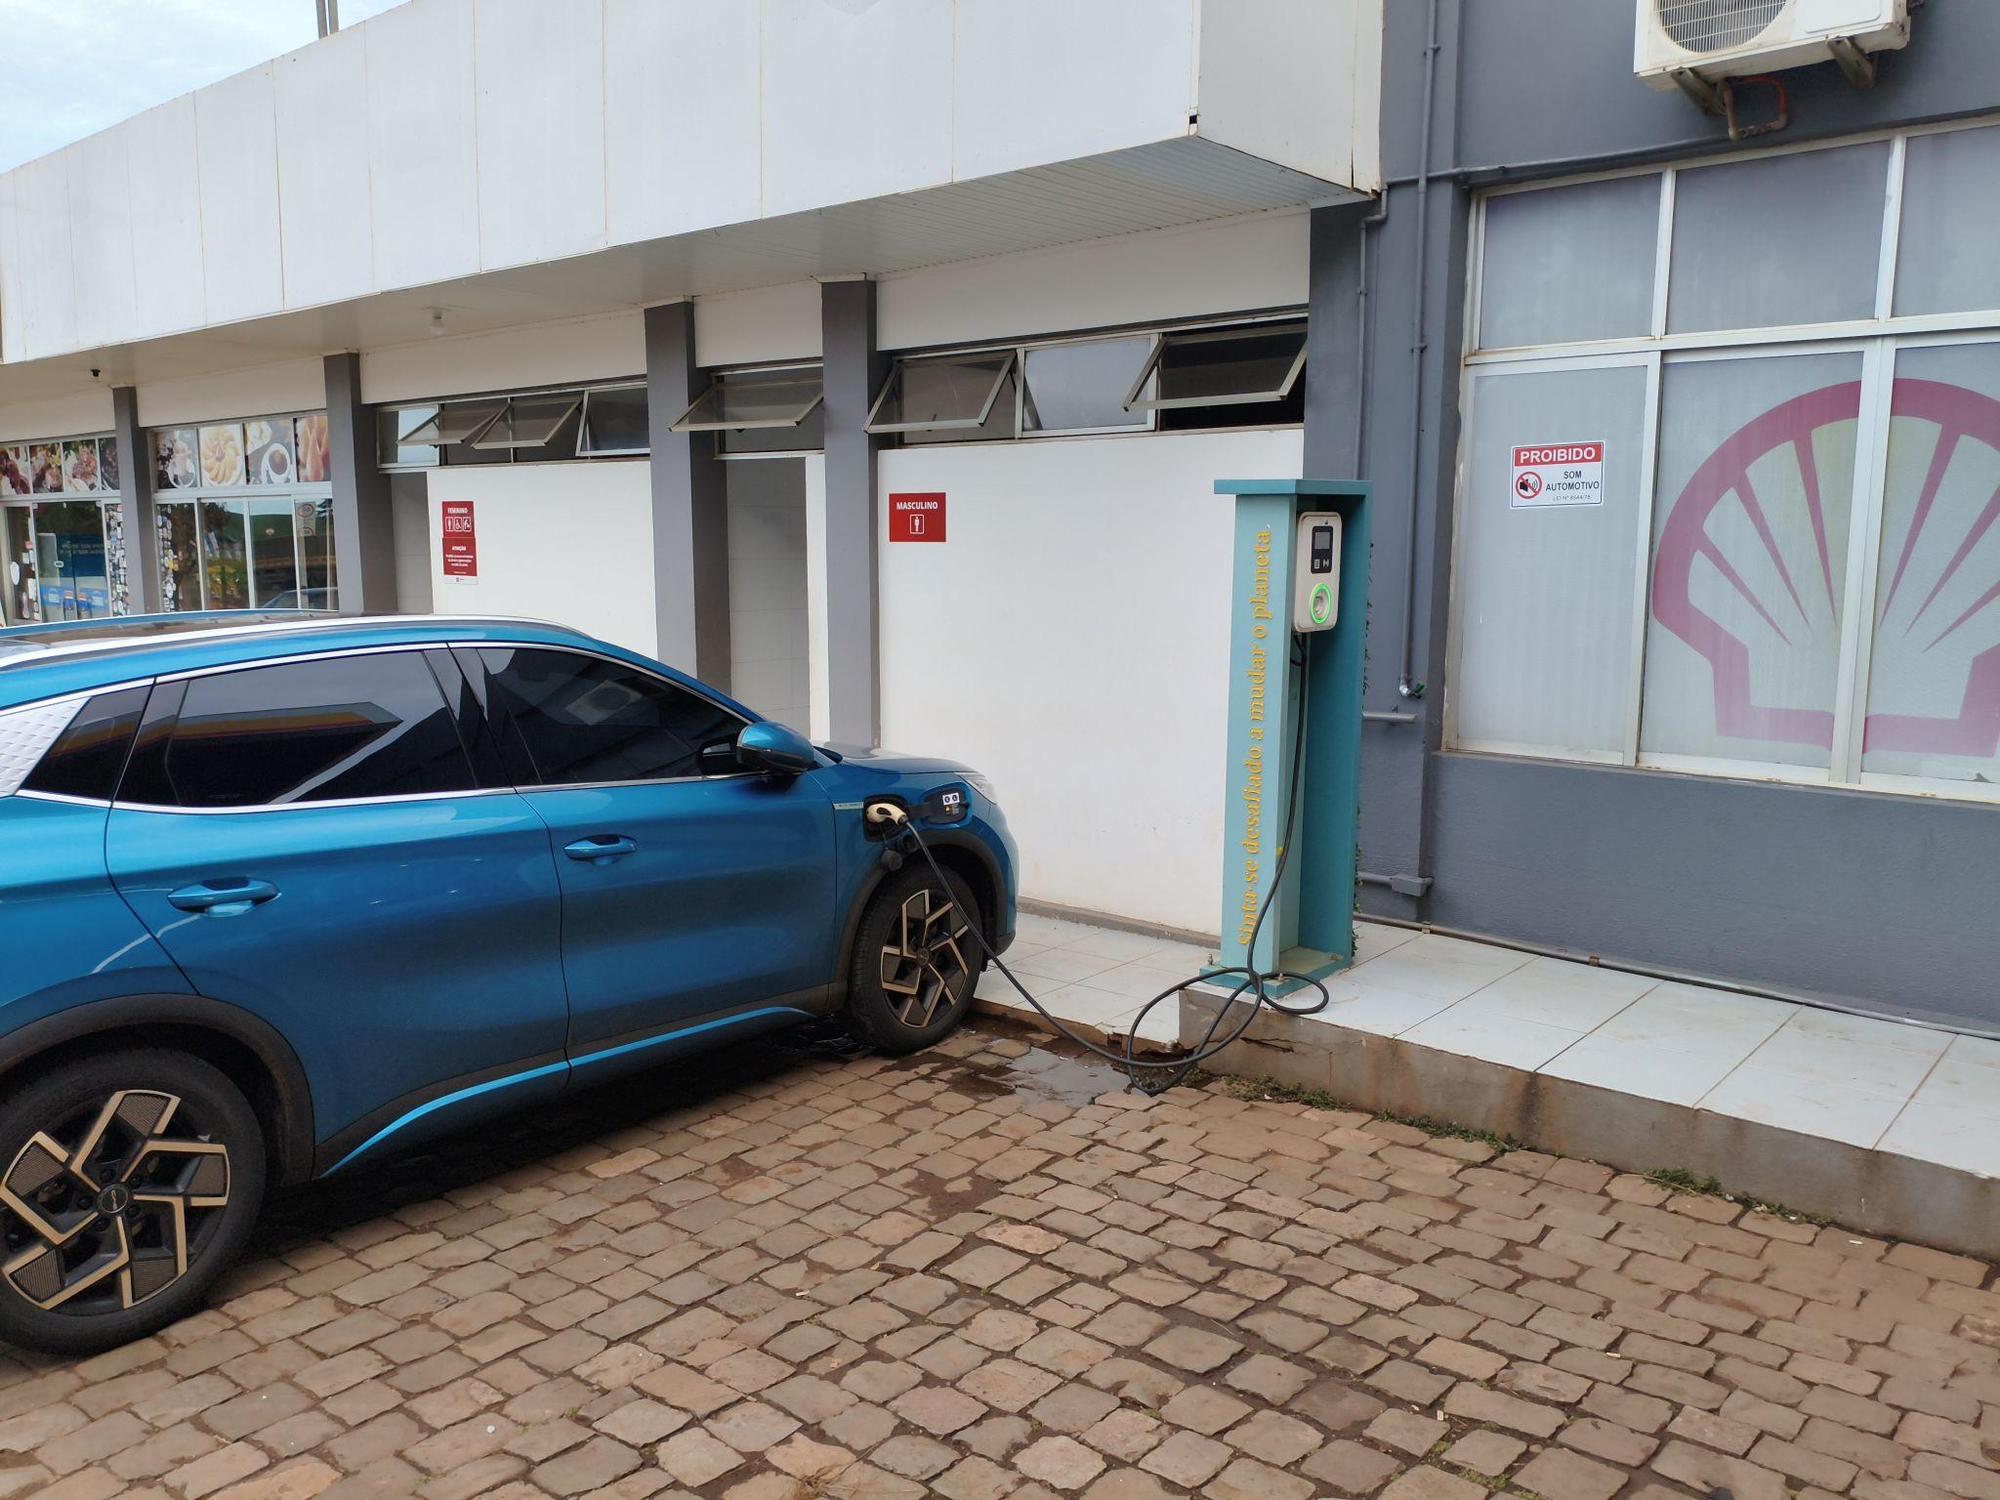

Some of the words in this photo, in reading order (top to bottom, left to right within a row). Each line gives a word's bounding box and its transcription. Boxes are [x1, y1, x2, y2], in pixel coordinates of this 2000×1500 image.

[1520, 447, 1595, 464] PROIBIDO
[1563, 470, 1582, 480] SOM
[1546, 481, 1600, 491] AUTOMOTIVO
[896, 501, 938, 510] MASCULINO
[1253, 624, 1268, 639] o
[1247, 643, 1266, 722] mudar
[1251, 728, 1263, 740] a
[1242, 746, 1263, 855] desafiado
